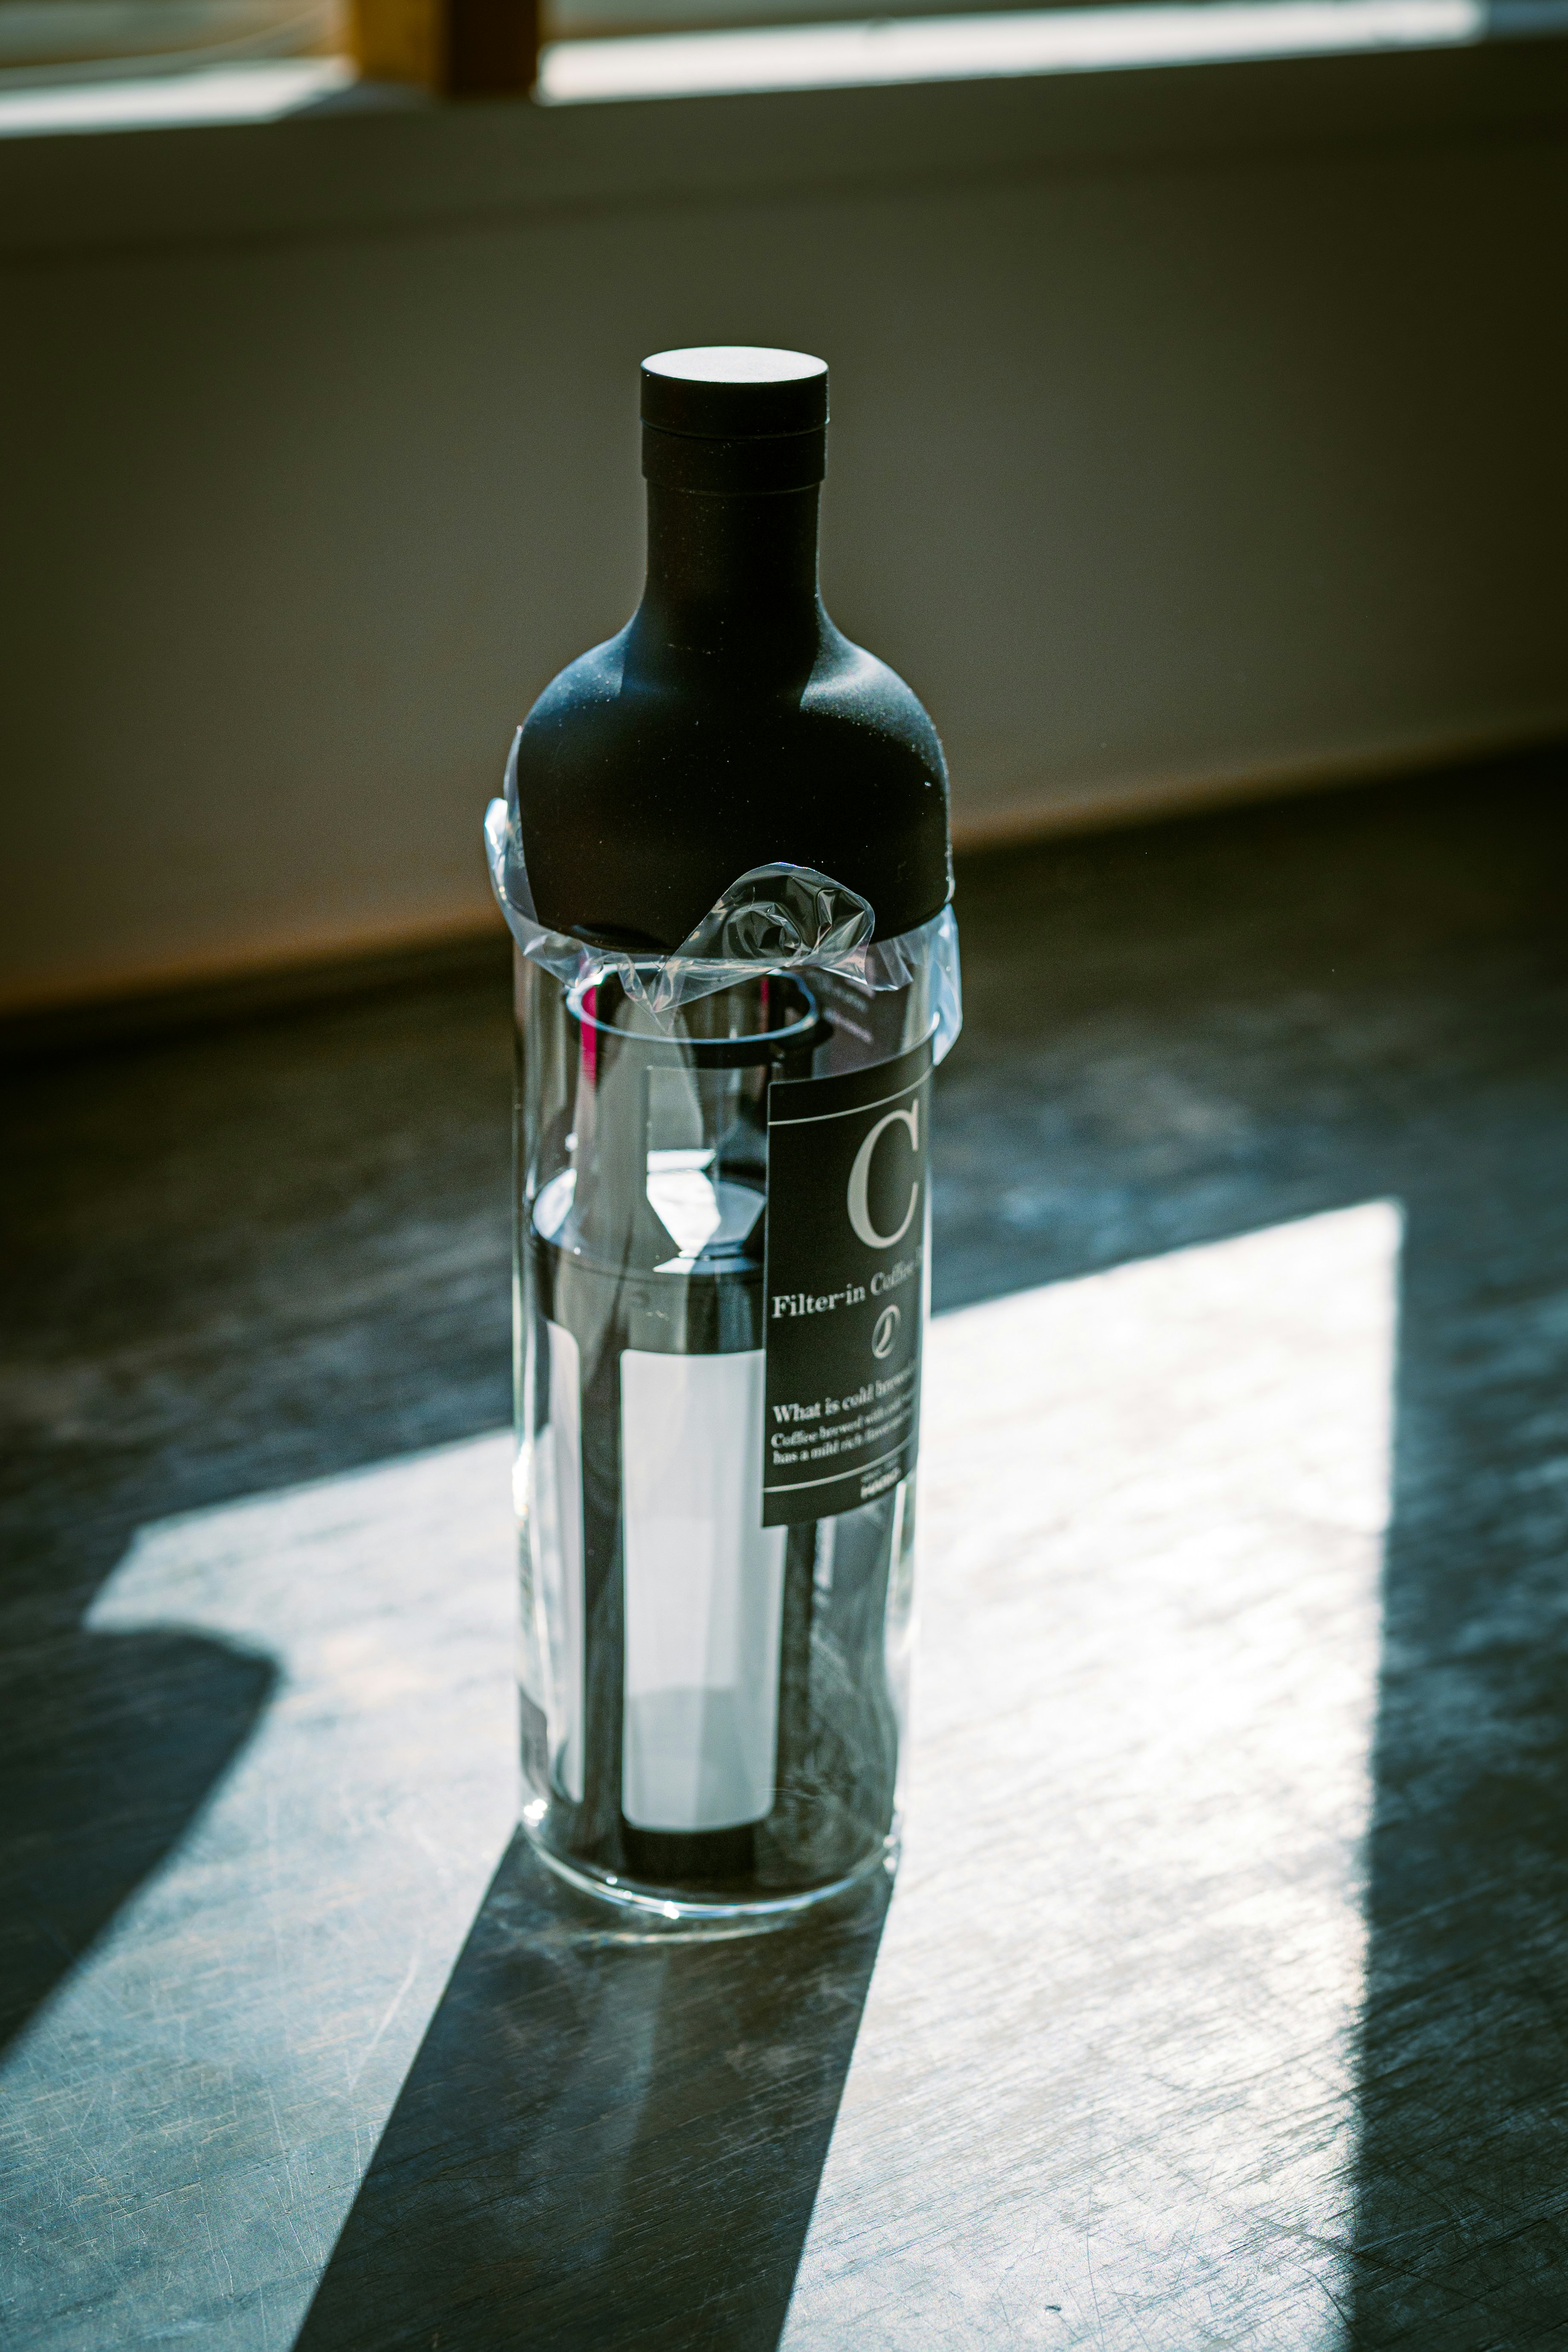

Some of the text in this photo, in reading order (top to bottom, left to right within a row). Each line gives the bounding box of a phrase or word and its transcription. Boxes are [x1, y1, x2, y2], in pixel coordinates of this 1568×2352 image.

[847, 1098, 919, 1249] C
[773, 1403, 821, 1423] What
[825, 1397, 841, 1416] is
[842, 1383, 874, 1411] cold
[771, 1430, 819, 1448] Coffee
[773, 1450, 799, 1466] has
[799, 1449, 810, 1462] a
[810, 1439, 840, 1460] mild
